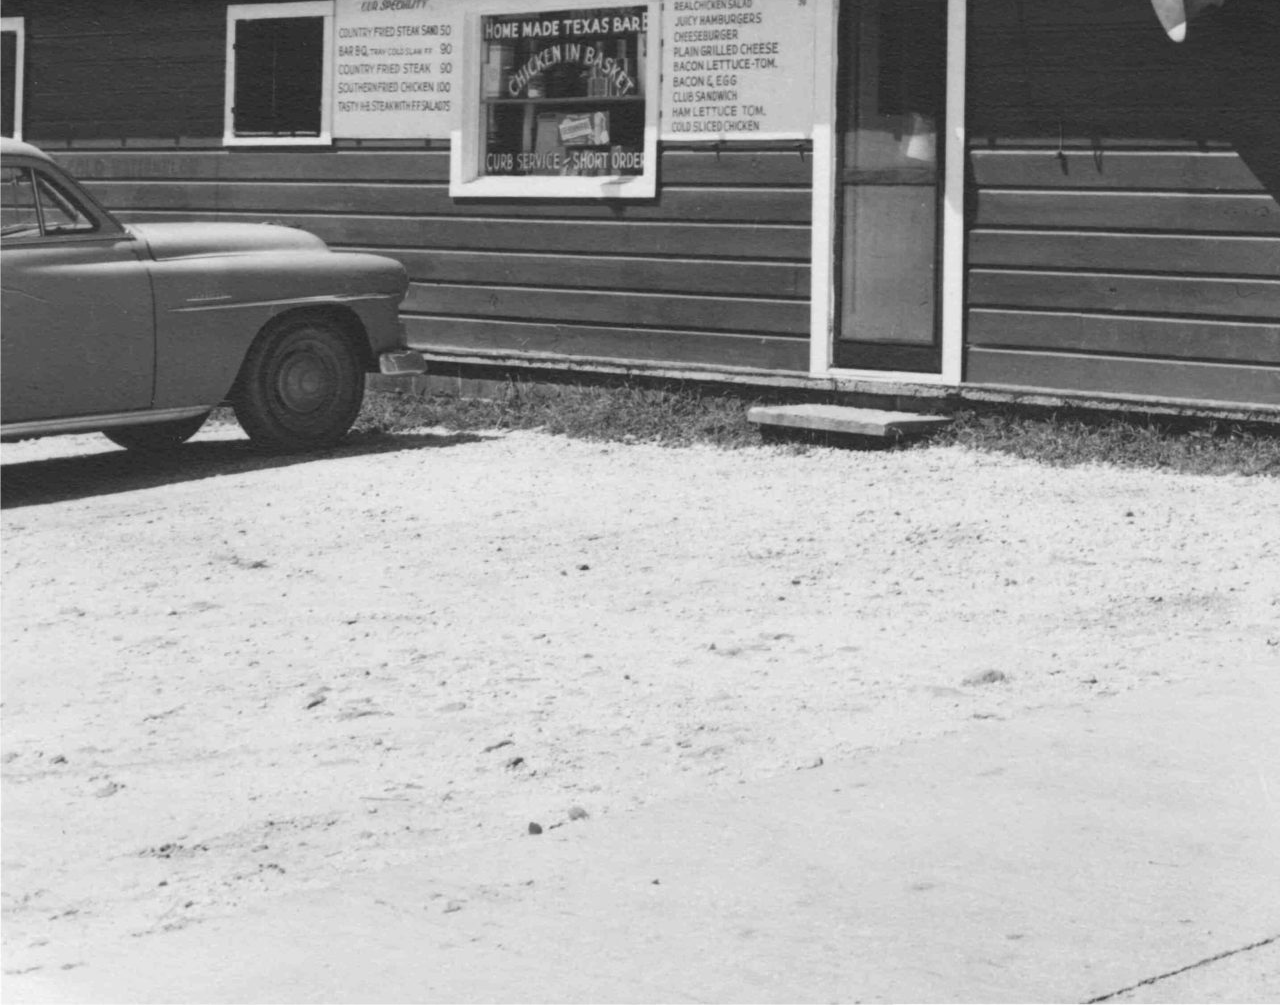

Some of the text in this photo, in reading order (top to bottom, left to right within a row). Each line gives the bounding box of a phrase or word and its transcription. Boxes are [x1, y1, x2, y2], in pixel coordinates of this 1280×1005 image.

[674, 1, 693, 12] REAL
[694, 0, 727, 11] CHICKEN
[675, 12, 762, 27] JUICY HAMBURGERS
[339, 26, 372, 39] COUNTRY
[374, 26, 395, 38] FRIED
[397, 25, 419, 37] STEAK
[486, 22, 519, 39] HOME
[522, 20, 560, 36] MADE
[563, 17, 609, 34] TEXAS
[674, 29, 738, 43] CHEESEBURGER
[673, 42, 779, 58] PLAIN GRILLED CHEESE
[338, 64, 375, 75] COUNTRY
[376, 63, 400, 75] FRIED
[403, 63, 431, 74] STEAK
[509, 44, 635, 96] CHICKEN IN BASKET
[673, 60, 704, 72] BACON
[338, 82, 377, 94] SOUTHERN
[377, 82, 398, 93] FRIED
[401, 81, 434, 93] CHICKEN
[673, 76, 704, 88] BACON
[716, 75, 737, 87] EGG
[673, 90, 738, 104] CLUB SANDWICH
[338, 101, 359, 112] TASTY
[371, 100, 393, 112] STEAK
[672, 107, 691, 118] HAM
[693, 106, 737, 118] LETTUCE
[671, 120, 760, 133] COLD SLICED CHICKEN
[487, 153, 513, 171] CURB
[517, 153, 560, 170] SERVICE
[573, 152, 608, 170] SHORT
